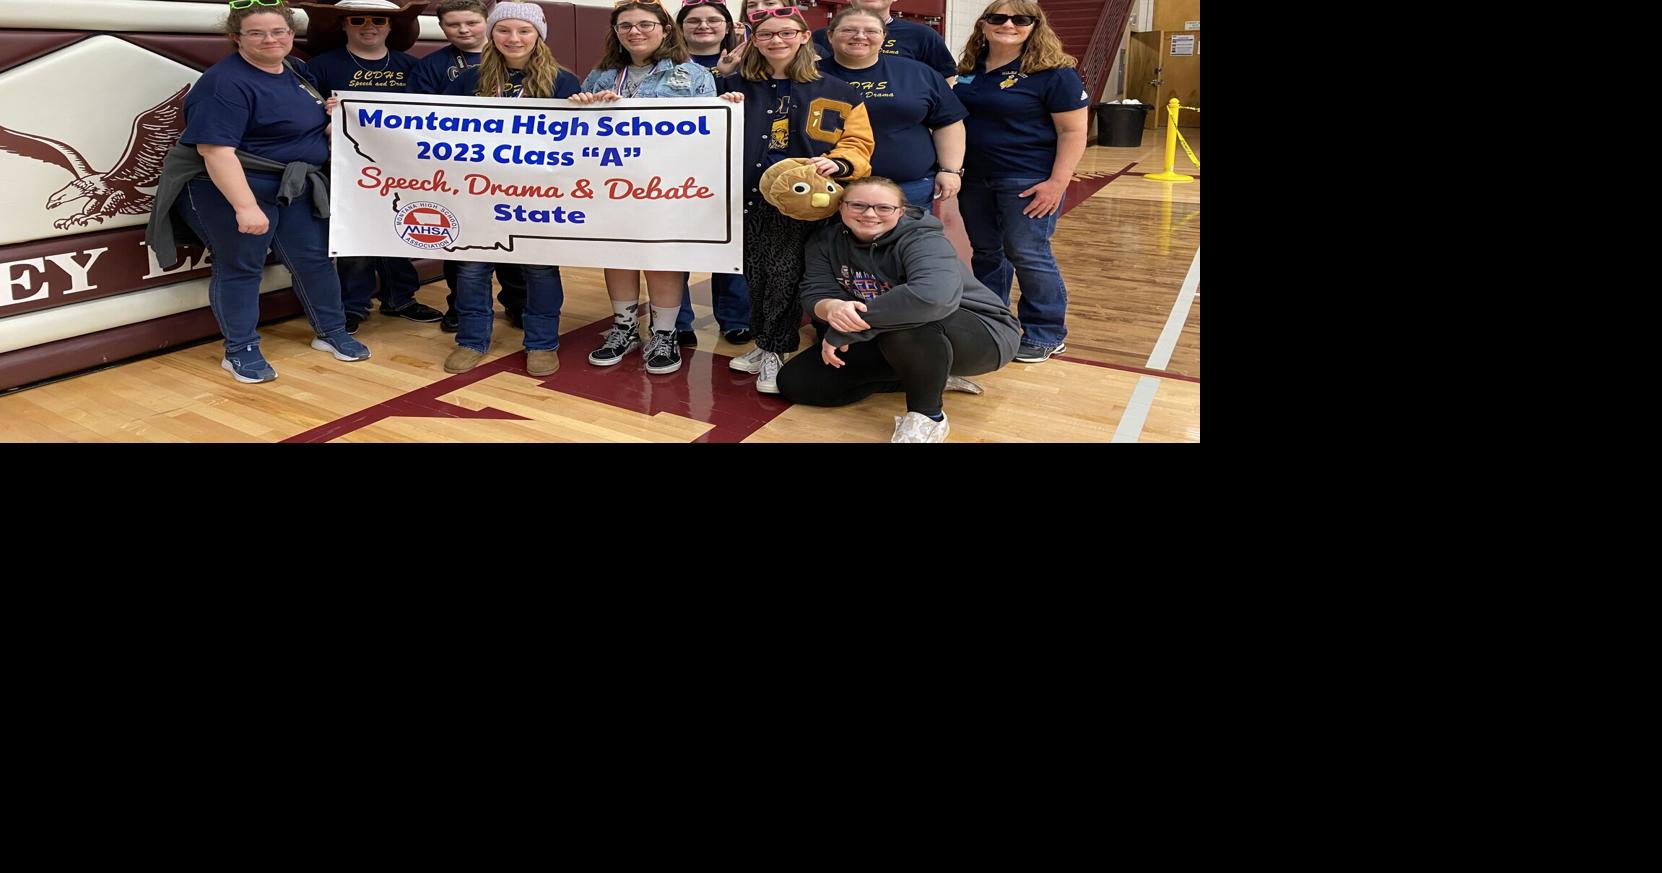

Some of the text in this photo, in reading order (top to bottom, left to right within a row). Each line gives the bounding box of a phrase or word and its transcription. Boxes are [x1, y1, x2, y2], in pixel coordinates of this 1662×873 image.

[358, 108, 711, 142] Montana High School
[416, 140, 486, 163] 2023
[492, 144, 575, 167] Class
[356, 165, 715, 201] Speech, Drama & Debate
[396, 203, 417, 226] MONTANA
[440, 207, 458, 230] SCHOOL
[494, 203, 586, 225] State
[401, 225, 454, 243] MHSA
[405, 237, 450, 249] ASSOCIATION
